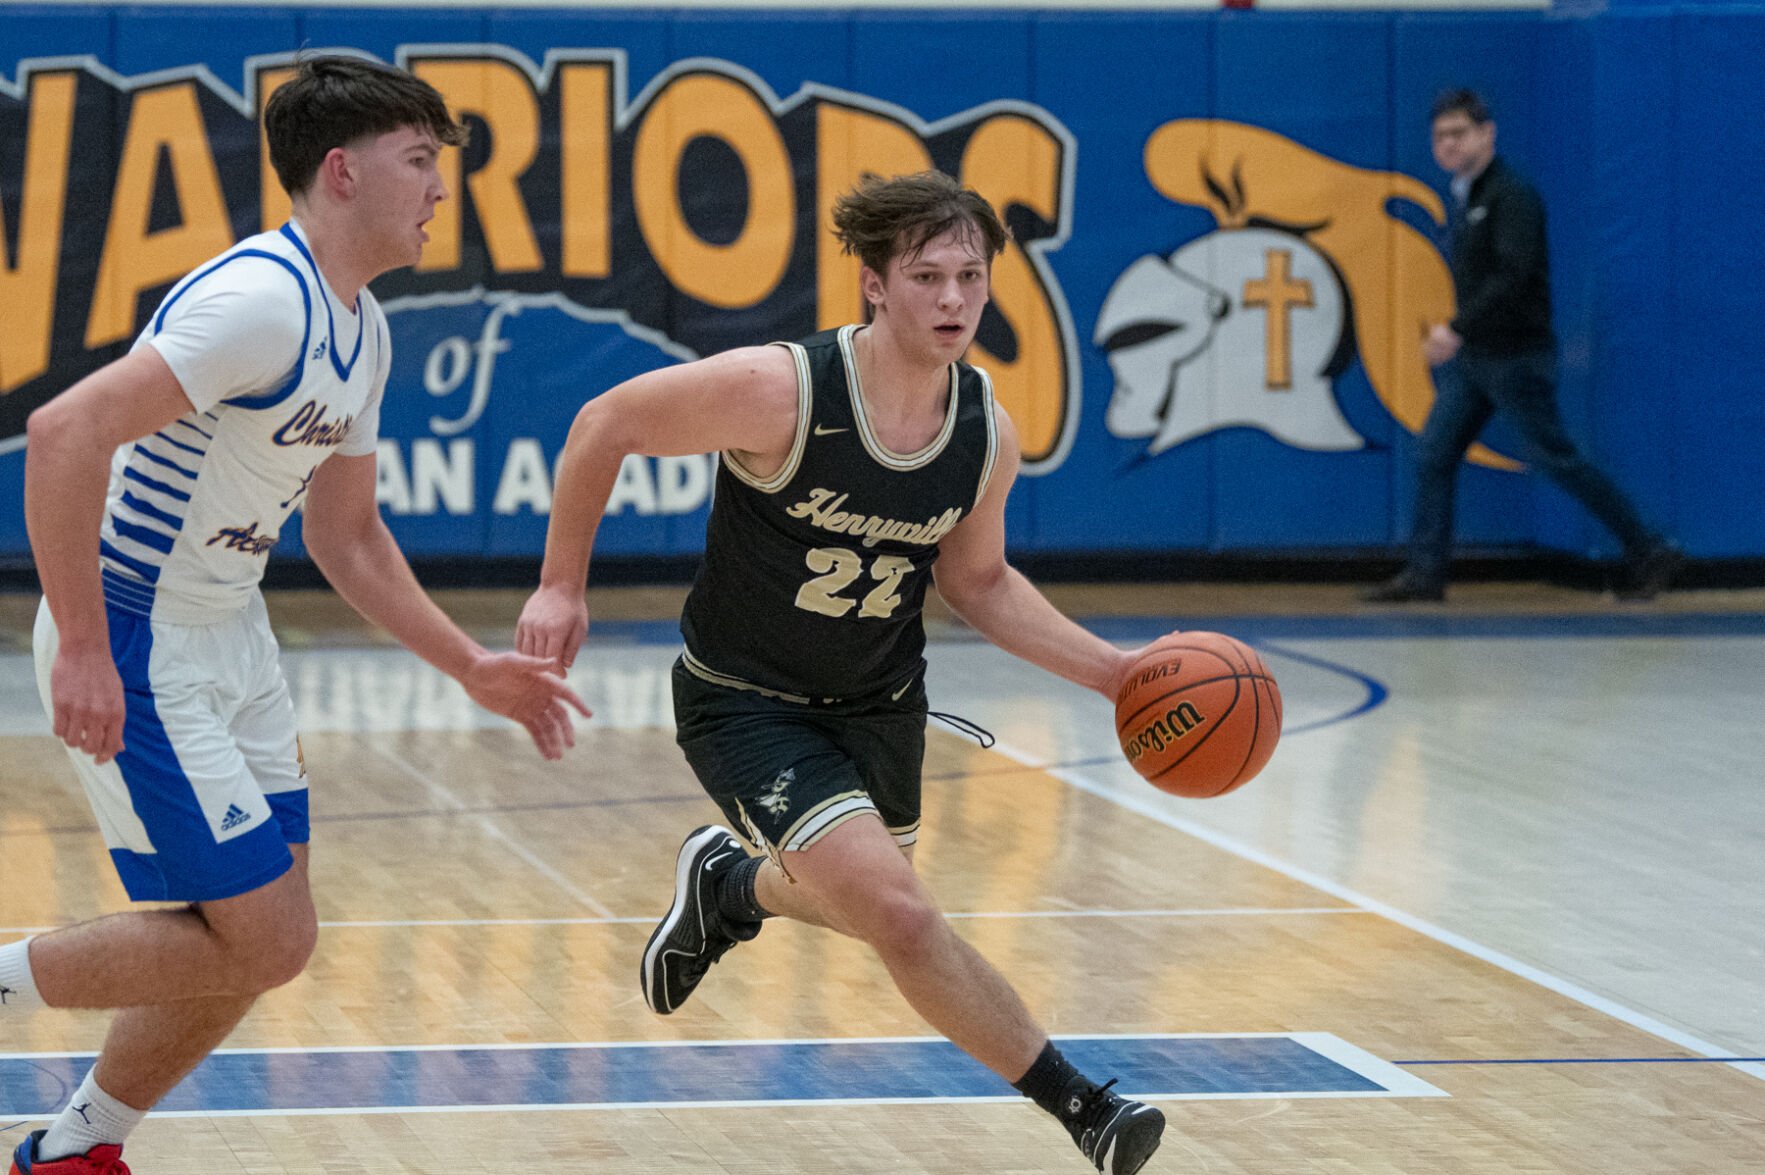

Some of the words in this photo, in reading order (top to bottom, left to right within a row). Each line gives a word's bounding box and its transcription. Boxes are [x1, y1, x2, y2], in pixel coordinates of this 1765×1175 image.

[423, 298, 510, 436] of
[376, 437, 476, 515] AN
[492, 437, 715, 515] AAD
[786, 488, 962, 548] Henryvill
[795, 547, 916, 618] 22
